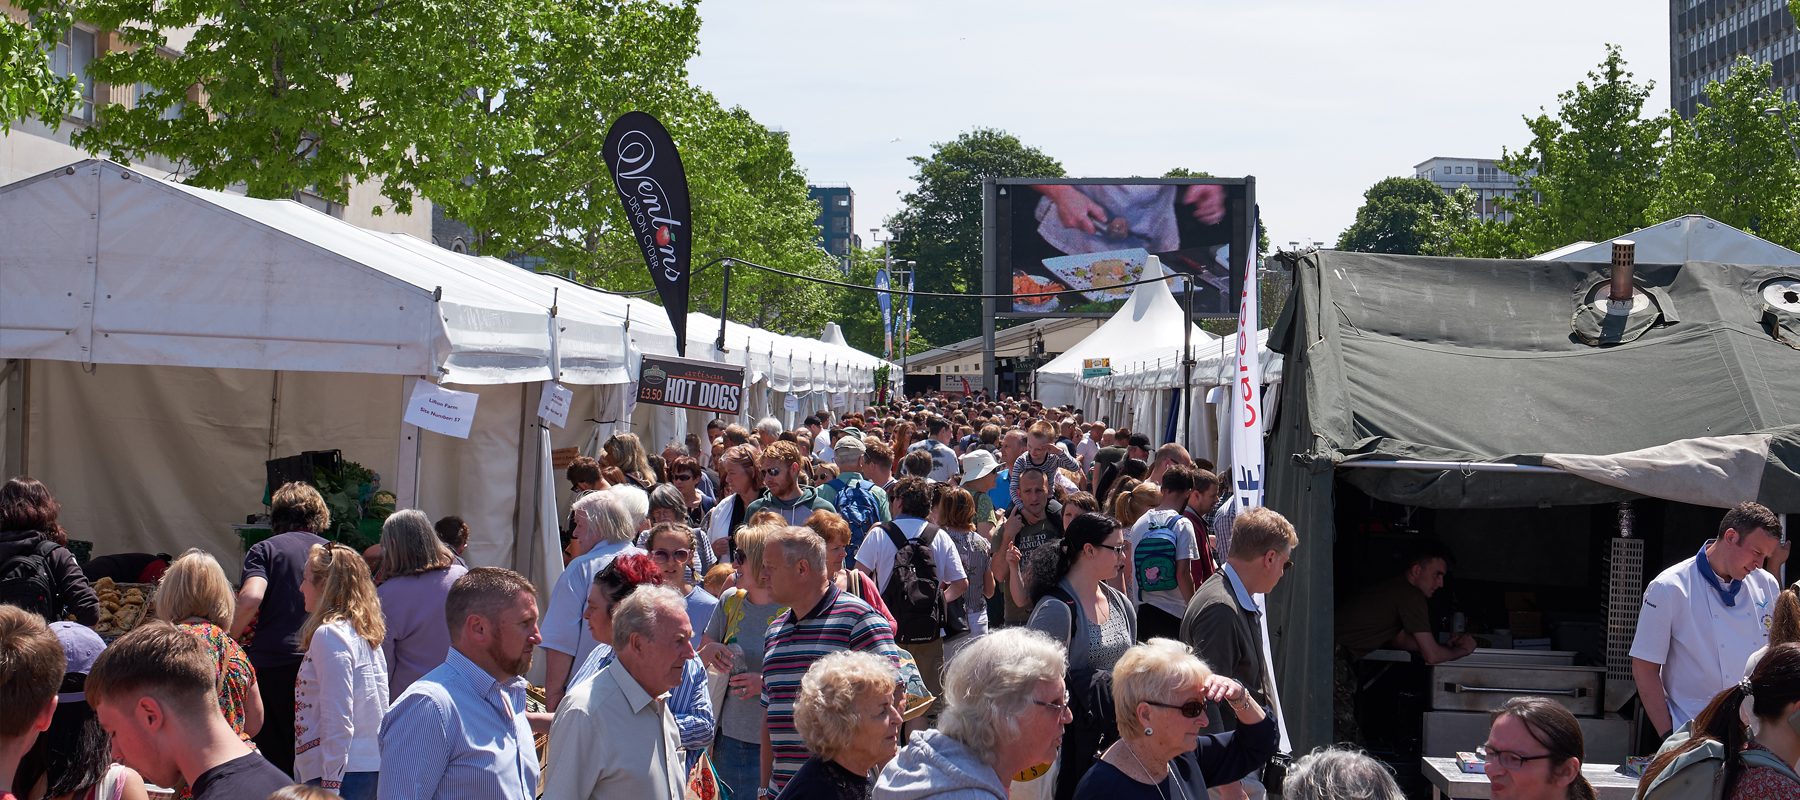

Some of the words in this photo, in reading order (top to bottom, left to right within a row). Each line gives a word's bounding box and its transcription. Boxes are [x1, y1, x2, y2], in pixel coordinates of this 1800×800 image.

[628, 195, 648, 233] DEVON
[643, 234, 659, 269] CYDER
[684, 370, 723, 380] artisan
[640, 387, 663, 401] £3.50
[664, 377, 696, 405] HOT
[698, 382, 740, 411] DOGS
[444, 402, 458, 410] Farm
[430, 411, 453, 421] Number:
